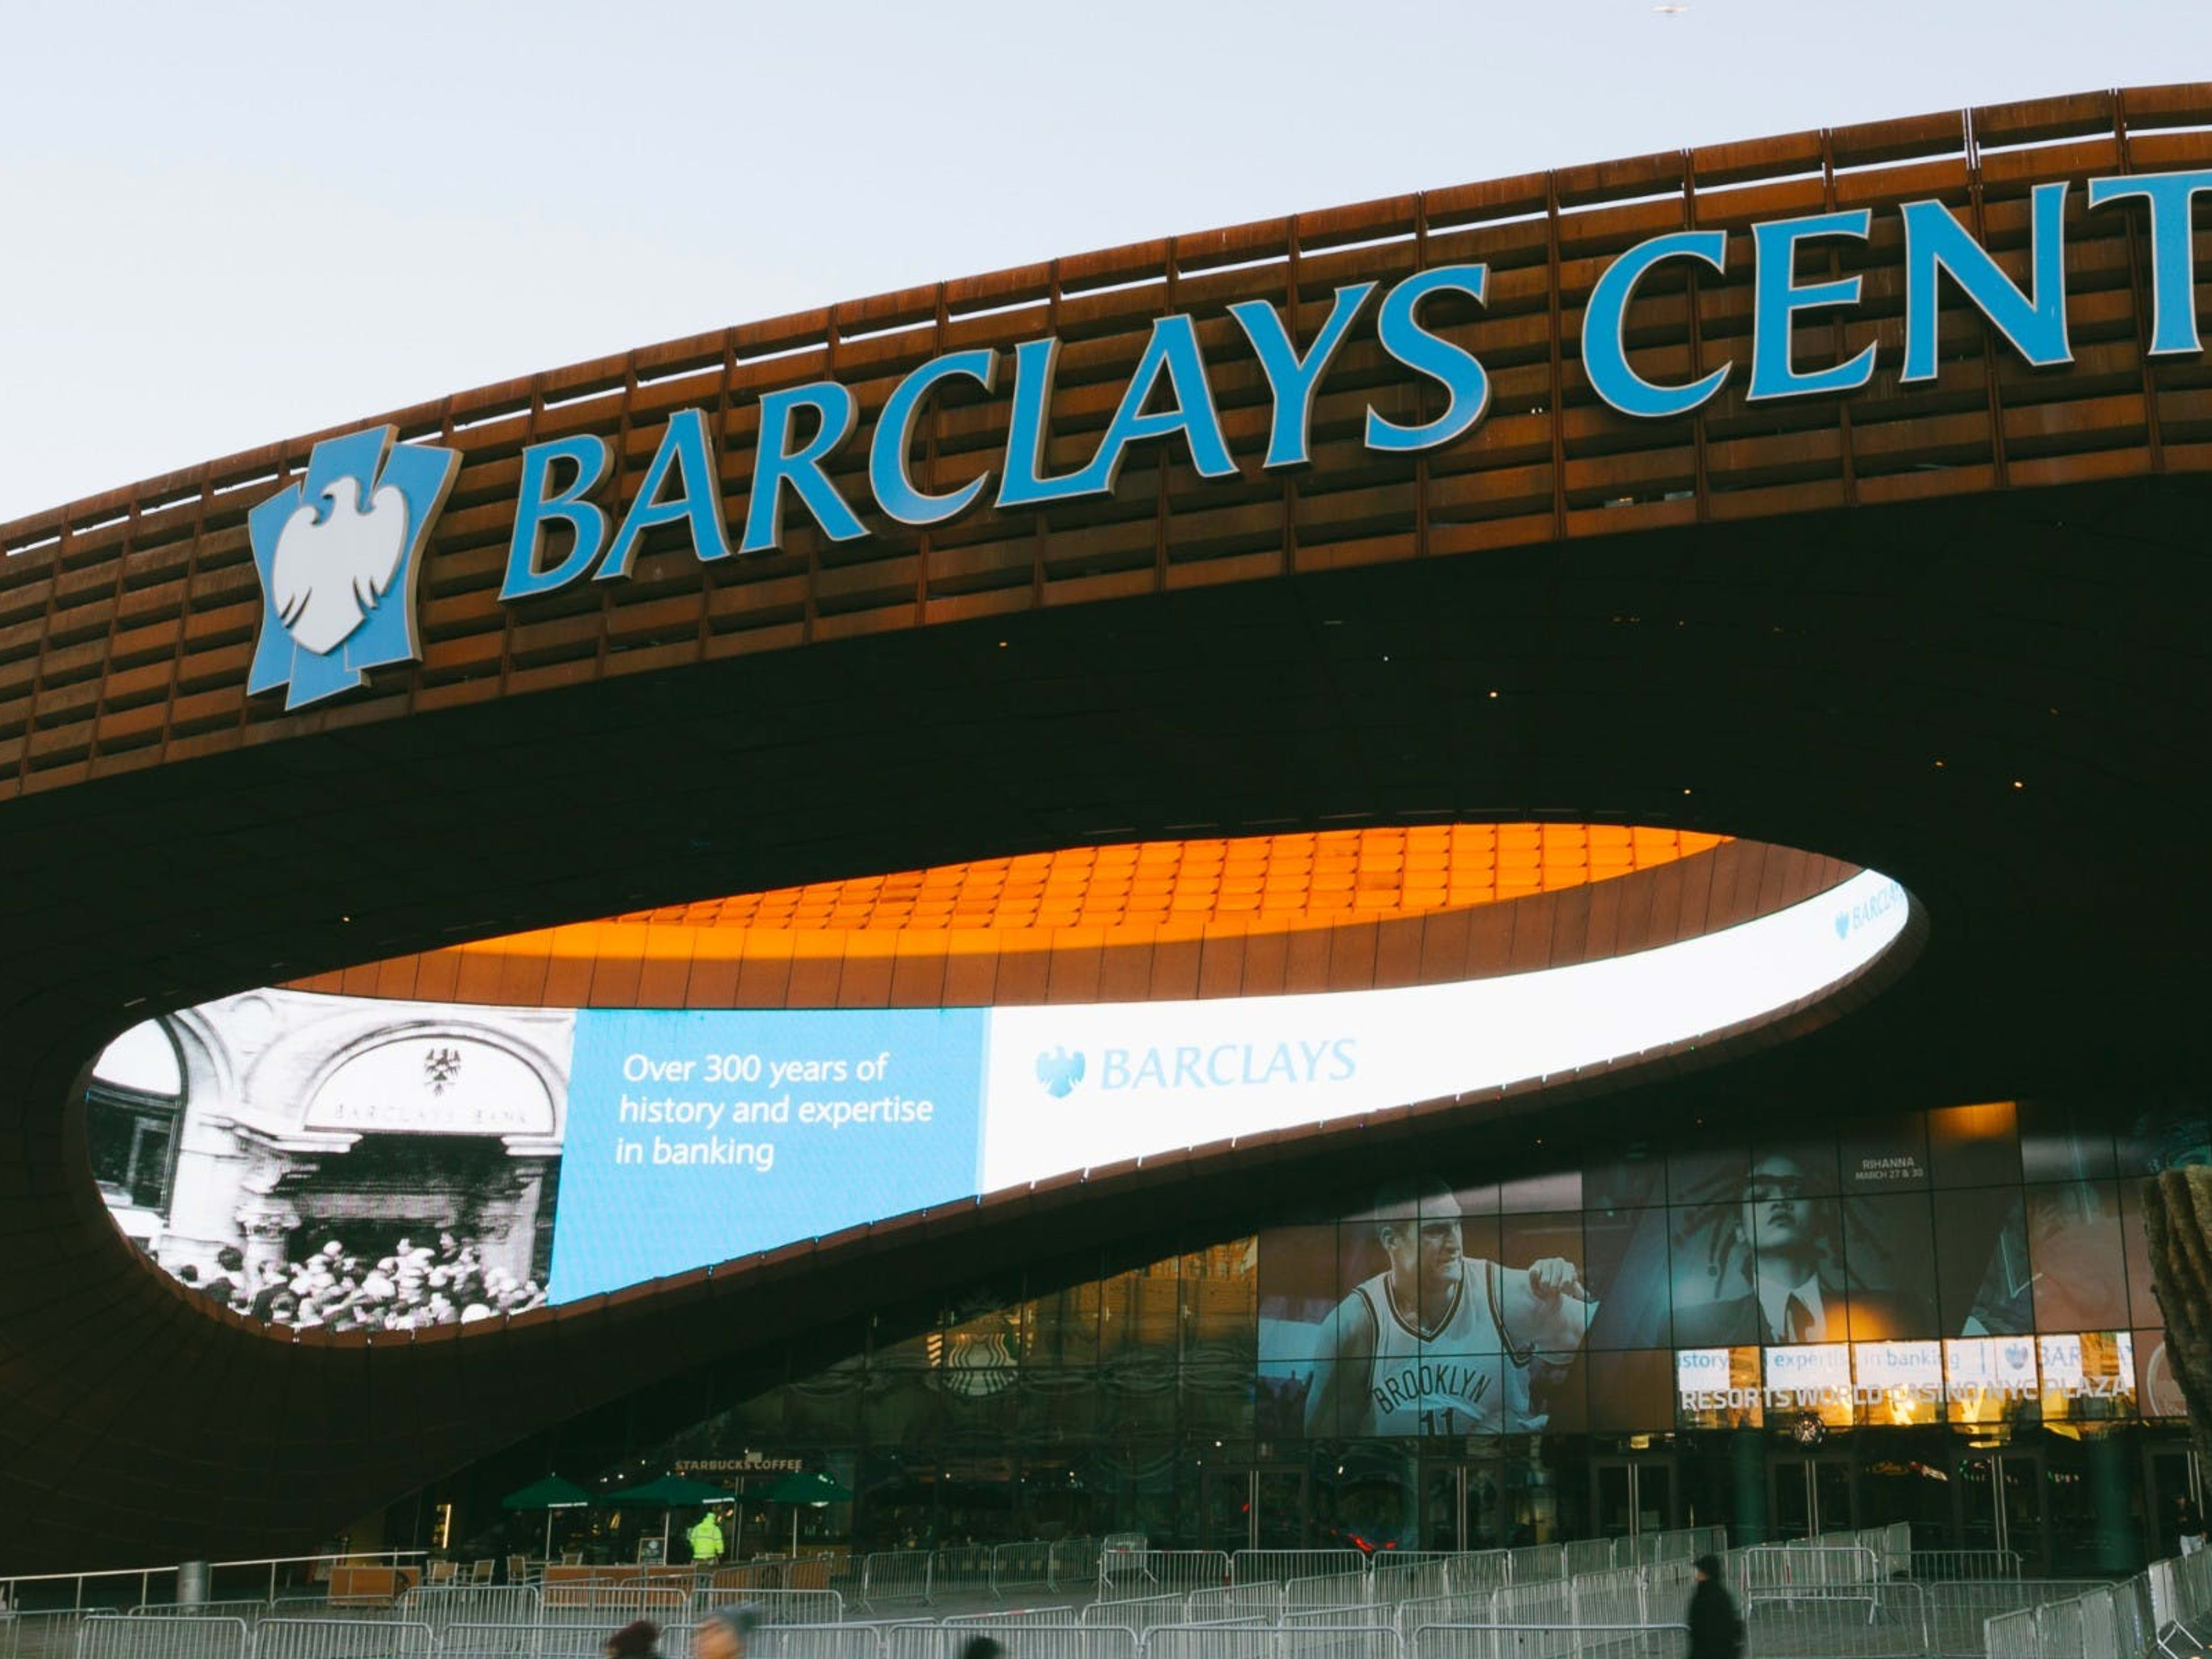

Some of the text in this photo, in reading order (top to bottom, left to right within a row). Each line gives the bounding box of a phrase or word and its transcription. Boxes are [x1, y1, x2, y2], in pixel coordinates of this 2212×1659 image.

[498, 263, 1492, 603] BARCLAYS
[623, 1052, 891, 1089] Over 300 years of
[1100, 1037, 1356, 1089] BARCLAYS
[619, 1094, 934, 1129] history and expertise
[616, 1135, 775, 1172] in banking
[1862, 1157, 1914, 1169] RIHANNA
[1372, 1364, 1491, 1414] BROOKLYN
[1681, 1374, 2130, 1412] RESORTS WORLD CASINO NYC PLAZA
[675, 1459, 803, 1470] STARBUCKS COFFEE
